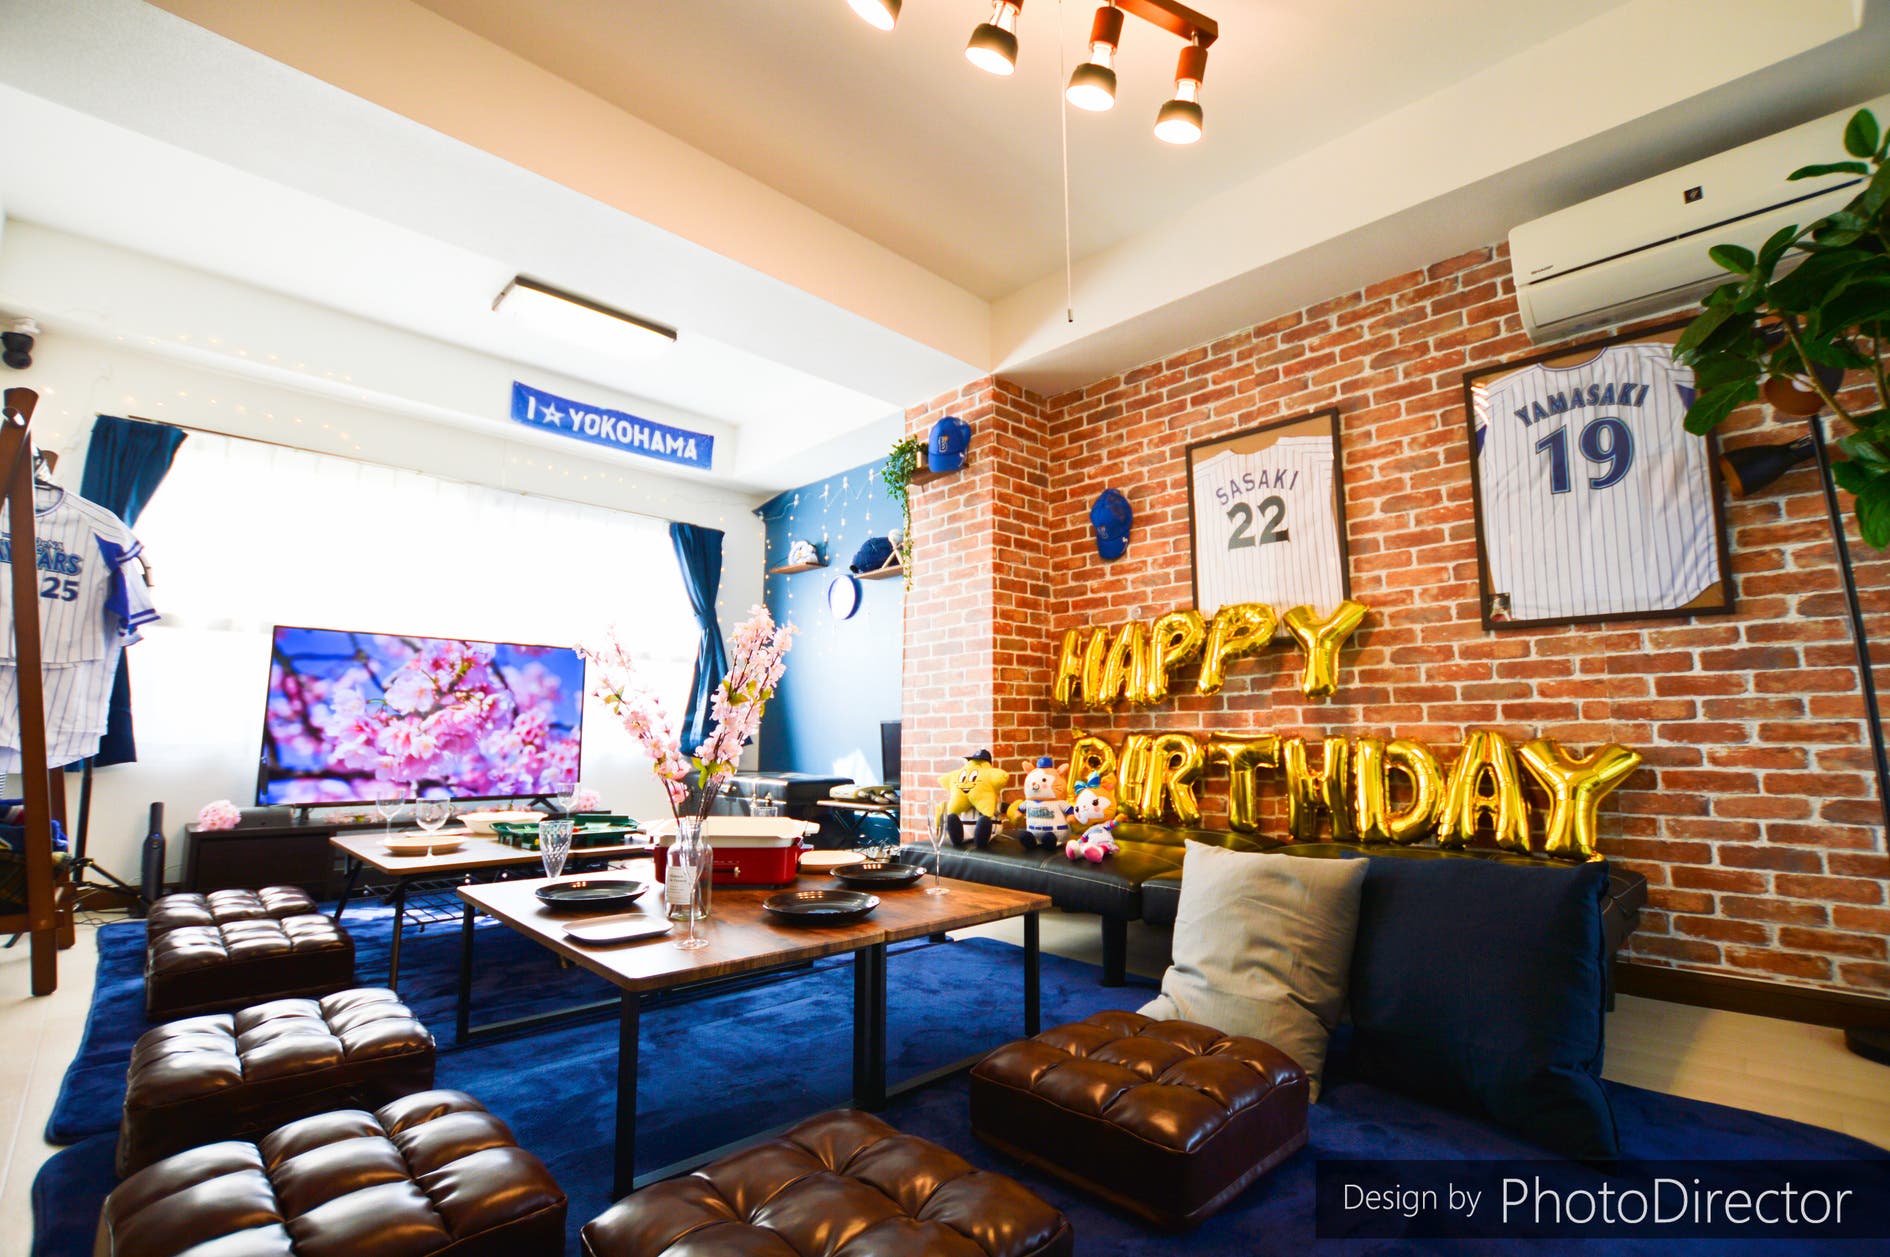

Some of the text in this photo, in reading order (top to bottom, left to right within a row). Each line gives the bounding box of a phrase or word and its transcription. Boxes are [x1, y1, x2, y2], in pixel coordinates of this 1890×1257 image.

[526, 396, 698, 461] I YOKOHAMA
[1514, 382, 1650, 428] YAMASAKI
[1535, 416, 1635, 495] 19
[1215, 468, 1299, 506] SASAKI
[1226, 495, 1291, 552] 22
[39, 576, 80, 602] 25
[1055, 600, 1371, 708] HAPPY
